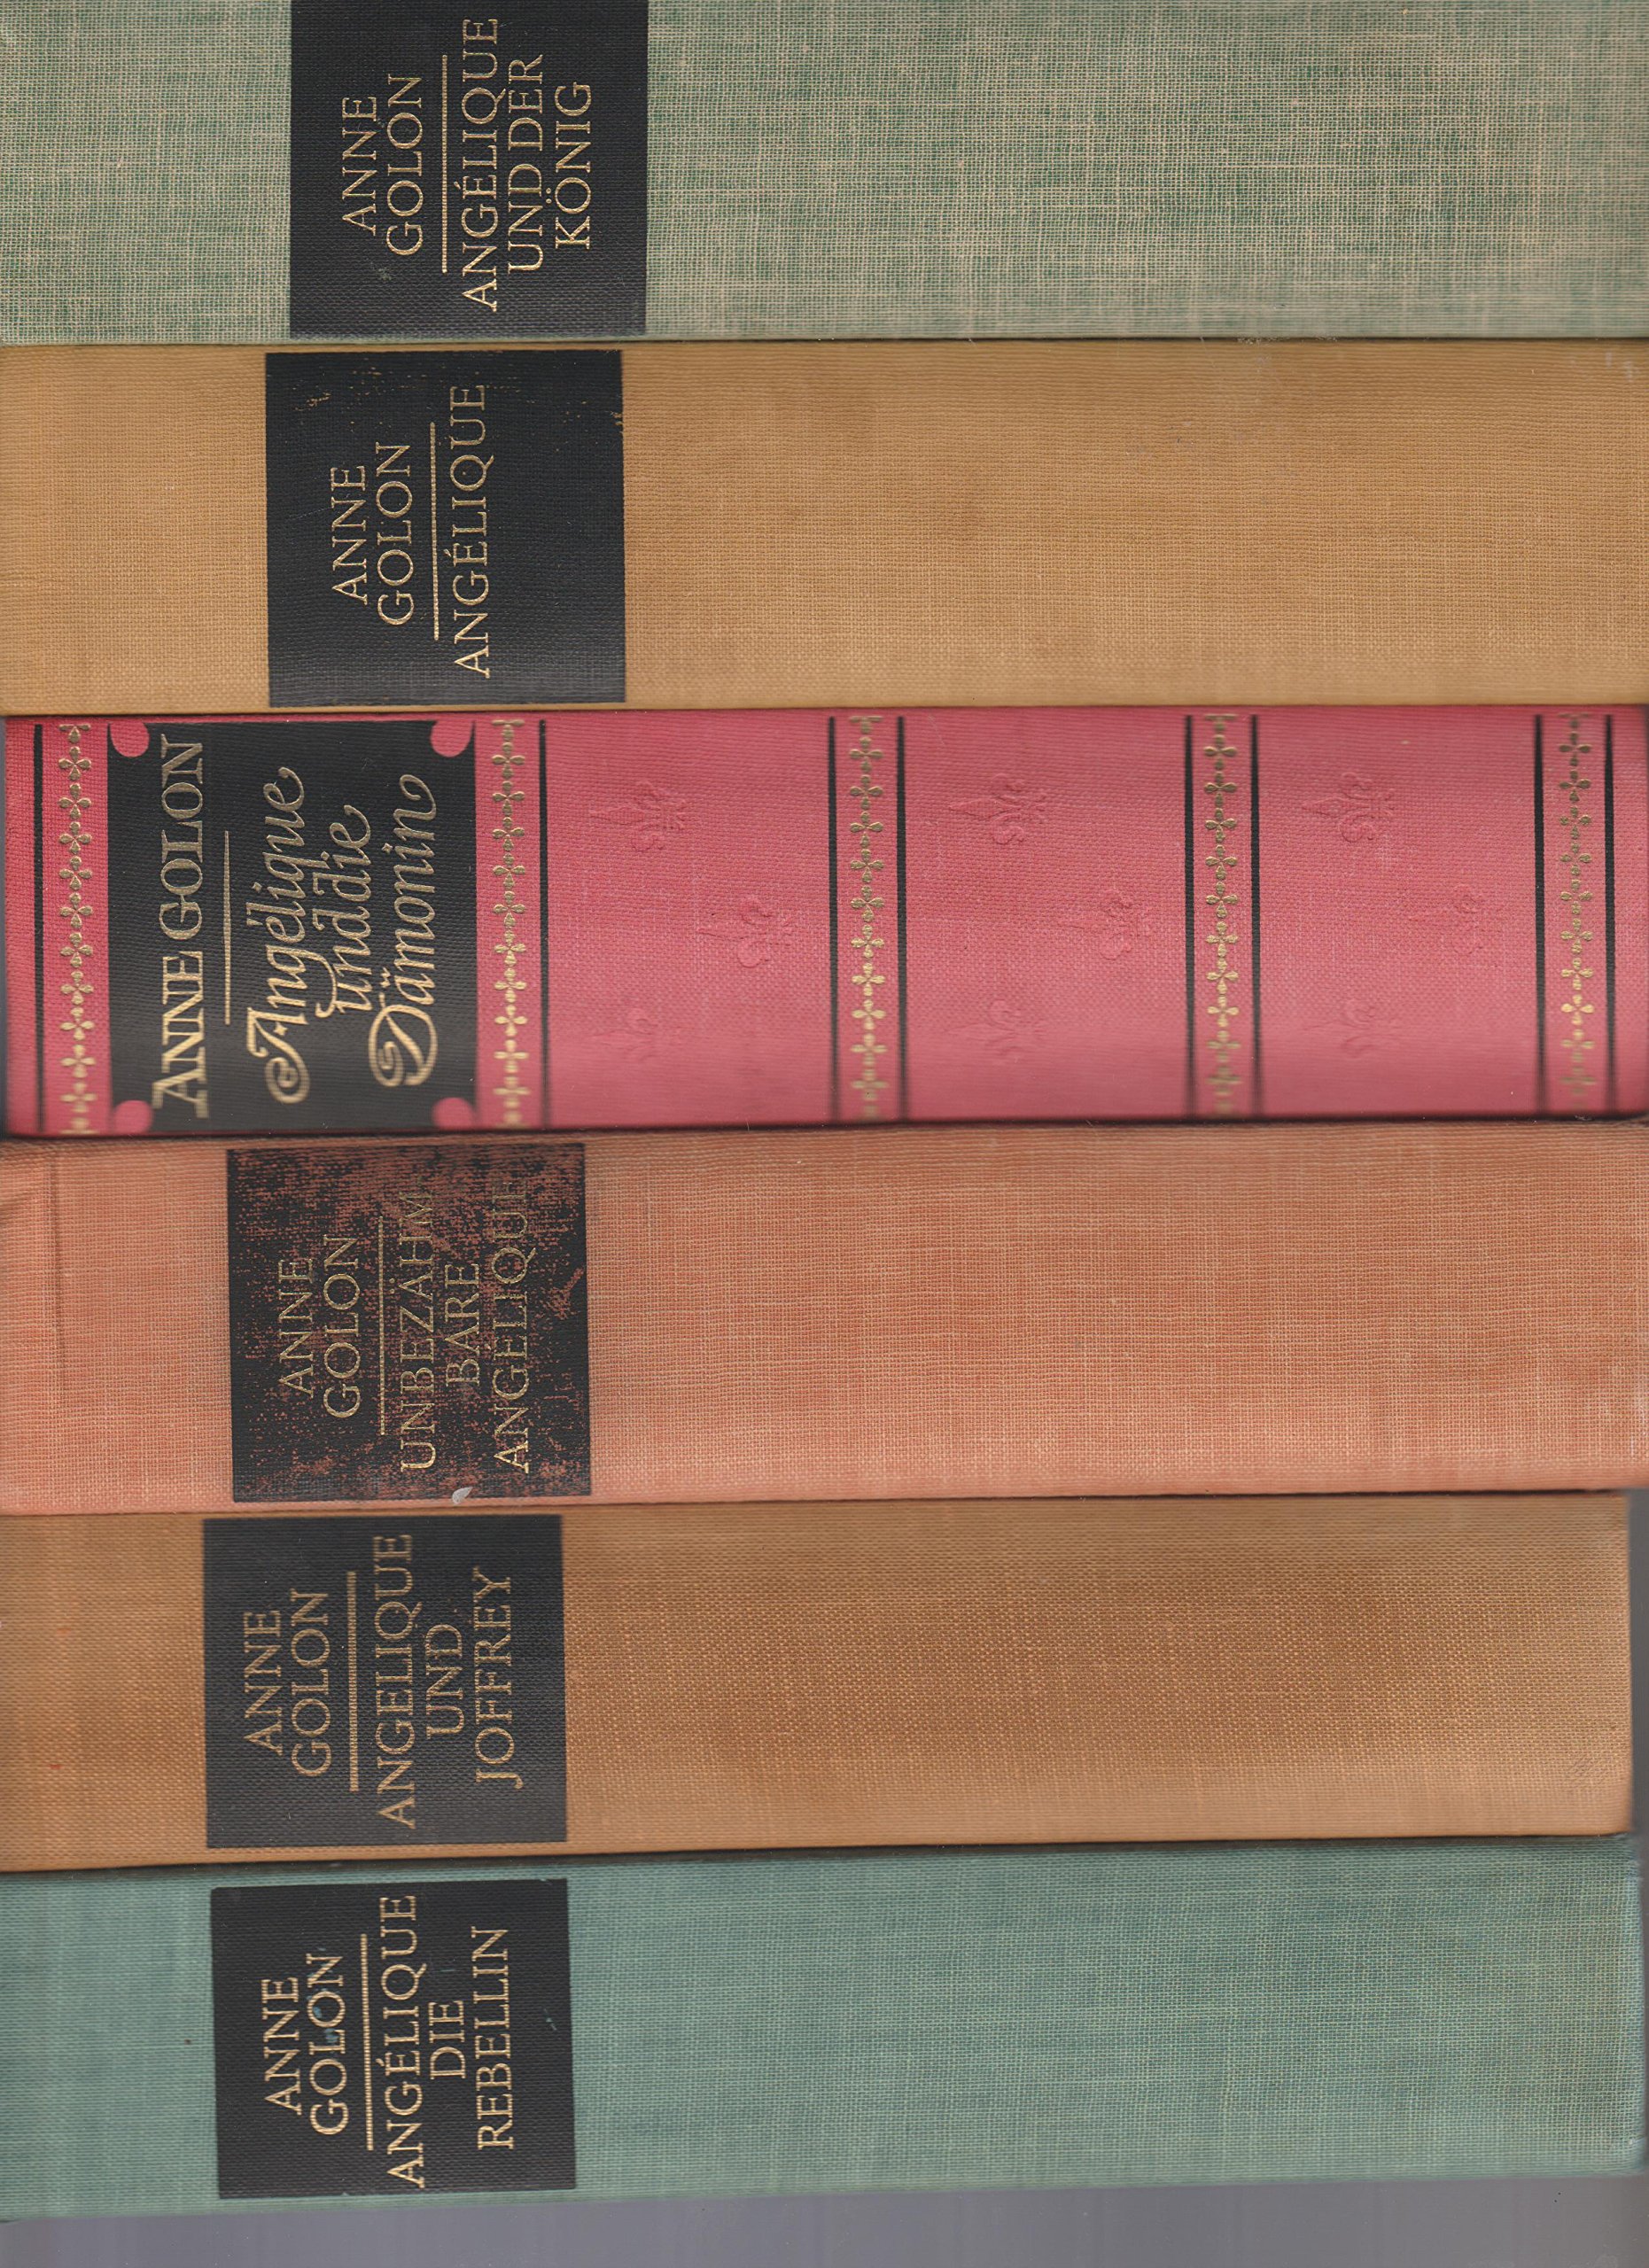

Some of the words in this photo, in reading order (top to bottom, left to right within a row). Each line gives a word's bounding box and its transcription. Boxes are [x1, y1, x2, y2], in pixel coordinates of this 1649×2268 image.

[342, 97, 377, 236] ANNE
[386, 74, 424, 255] GOLON
[454, 19, 506, 312] ANGÉLIQUE
[509, 54, 543, 151] DER
[546, 82, 591, 249] KÖNIG
[508, 164, 543, 273] UND
[331, 465, 368, 605] ANNE
[376, 442, 414, 625] GOLON
[443, 384, 494, 679] ANGÉLIQUE
[159, 734, 203, 940] GOLON
[312, 804, 372, 903] die
[312, 907, 372, 1014] und
[368, 774, 438, 1087] Dämonin
[152, 951, 209, 1118] ANNE
[278, 1258, 314, 1398] ANNE
[323, 1234, 361, 1418] GOLON
[445, 1263, 480, 1386] BARE
[243, 1609, 283, 1756] ANNE
[290, 1588, 331, 1776] GOLON
[373, 1534, 423, 1829] ANGELIQUE
[425, 1624, 464, 1740] UND
[472, 1565, 523, 1789] JOFFREY
[261, 1977, 301, 2116] ANNE
[307, 1953, 349, 2135] GOLON
[376, 1895, 426, 2188] ANGÉLIQUE
[428, 2000, 466, 2079] DIE
[471, 1926, 514, 2150] REBELLIN
